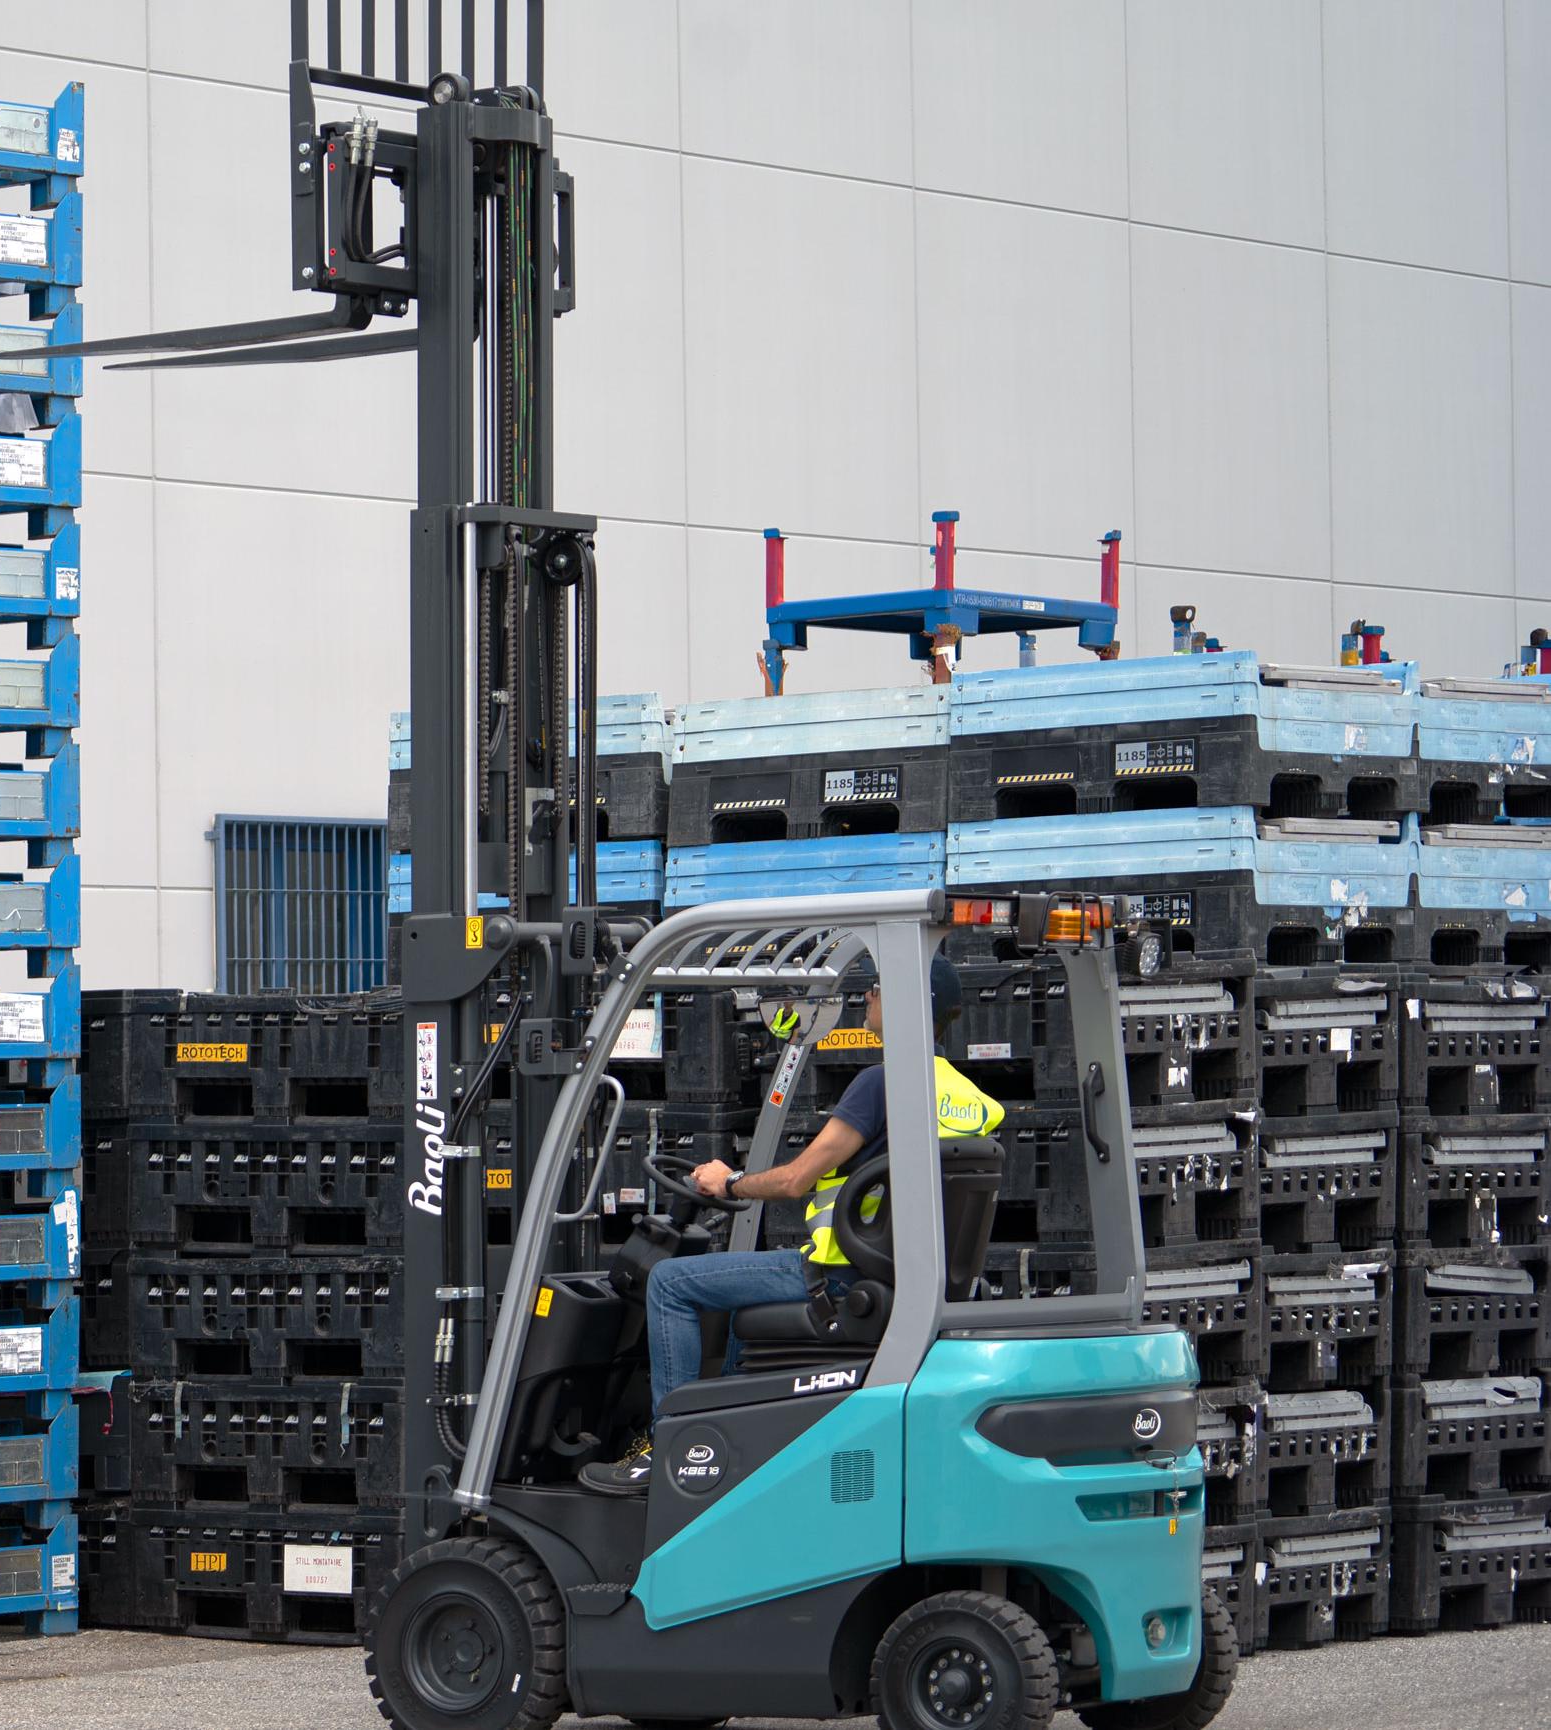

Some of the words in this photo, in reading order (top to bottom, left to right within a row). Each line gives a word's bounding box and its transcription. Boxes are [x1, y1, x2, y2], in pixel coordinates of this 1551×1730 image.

[1117, 750, 1146, 761] 1185
[826, 779, 853, 789] 1185
[181, 1047, 243, 1059] ROTOTECH
[939, 1093, 978, 1121] Baoli
[408, 1102, 446, 1217] Baoli
[1135, 1413, 1156, 1430] Baoli
[688, 1447, 710, 1459] Baoli
[678, 1466, 708, 1476] KBE
[295, 1557, 309, 1566] STILL
[312, 1557, 342, 1567] MONTATAIRE
